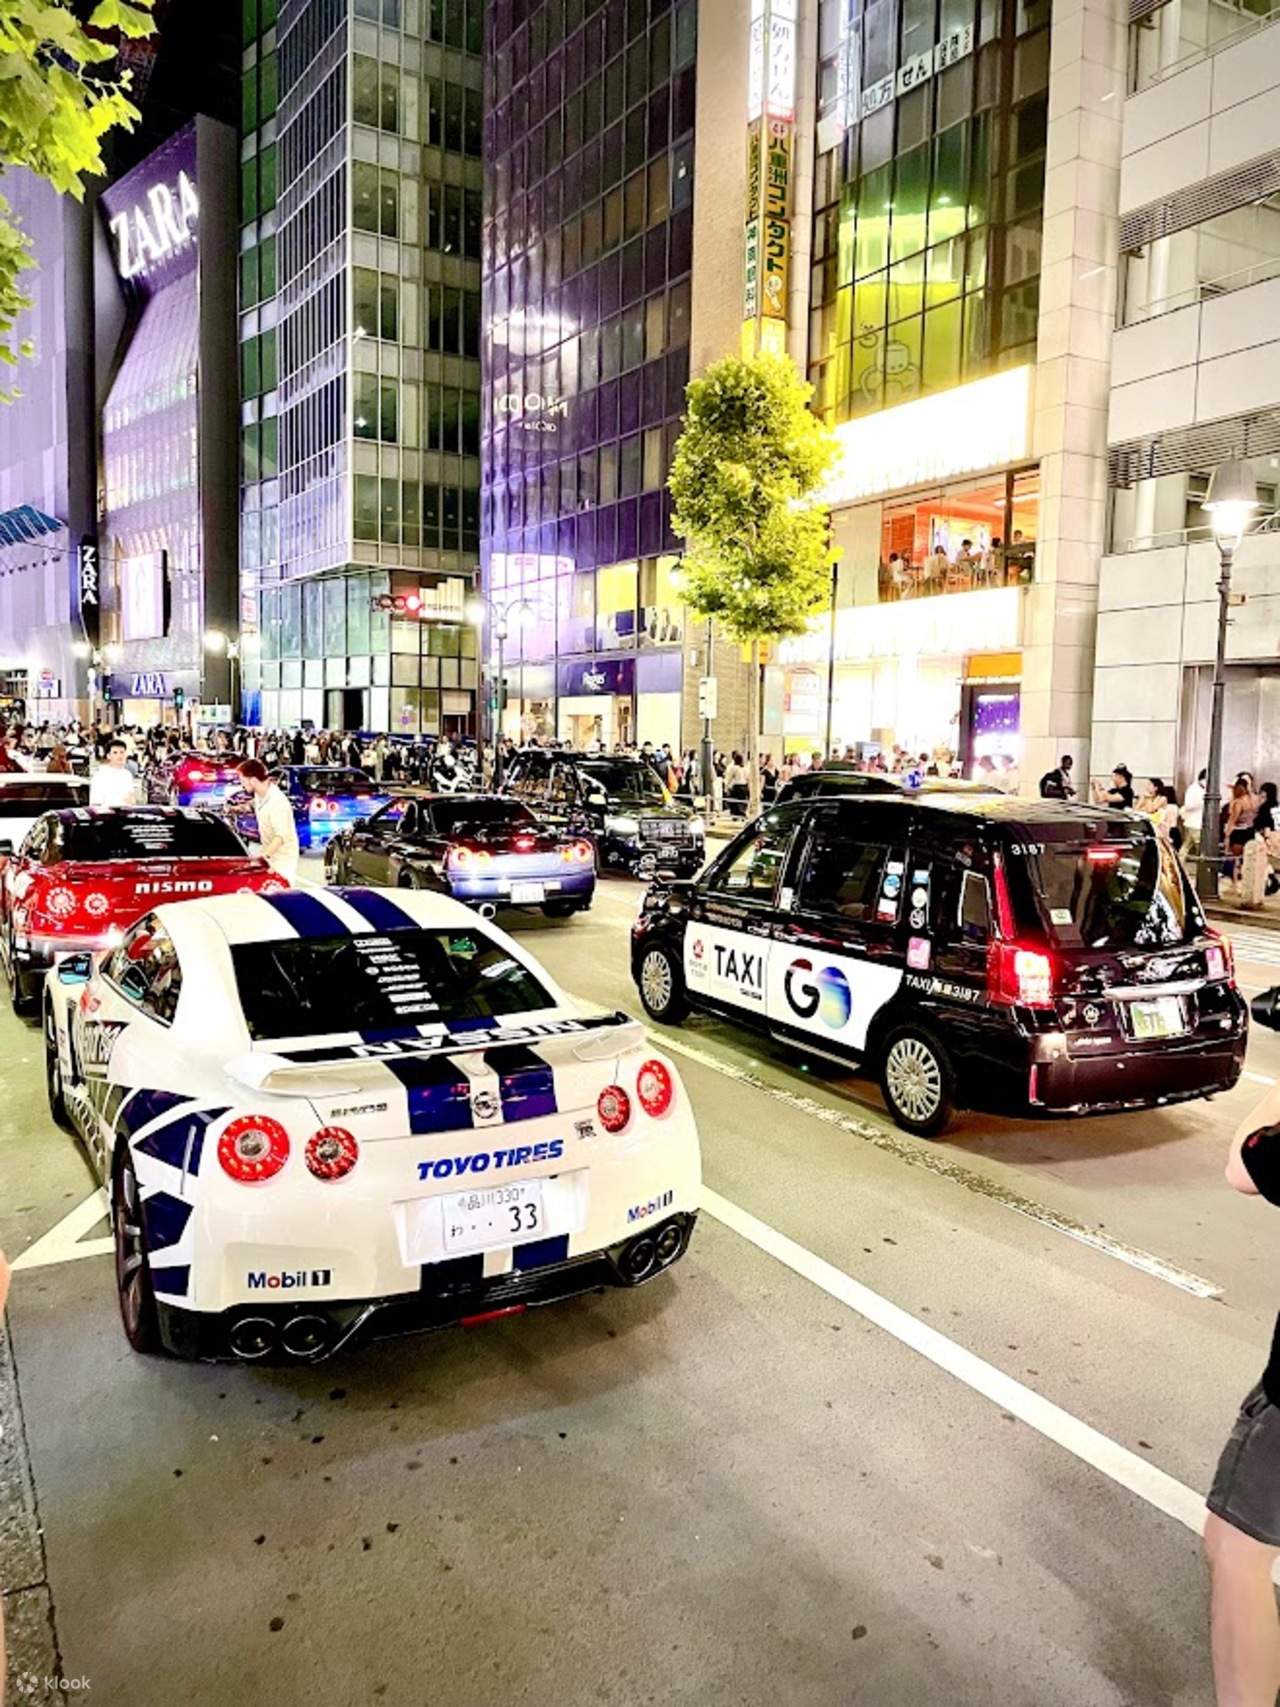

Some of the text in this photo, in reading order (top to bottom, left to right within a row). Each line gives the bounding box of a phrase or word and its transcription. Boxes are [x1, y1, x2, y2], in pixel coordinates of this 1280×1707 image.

[109, 169, 199, 279] ZARA
[768, 137, 787, 271] 八重洲コンタクト
[82, 545, 98, 604] ZARA
[131, 674, 166, 695] ZARA
[714, 945, 762, 988] TAXI
[784, 958, 852, 1029] GO
[350, 1019, 587, 1057] NISSAN
[417, 1139, 563, 1180] TOYO TIRES
[627, 1196, 661, 1224] Mobil
[248, 1270, 330, 1288] Mobil 1
